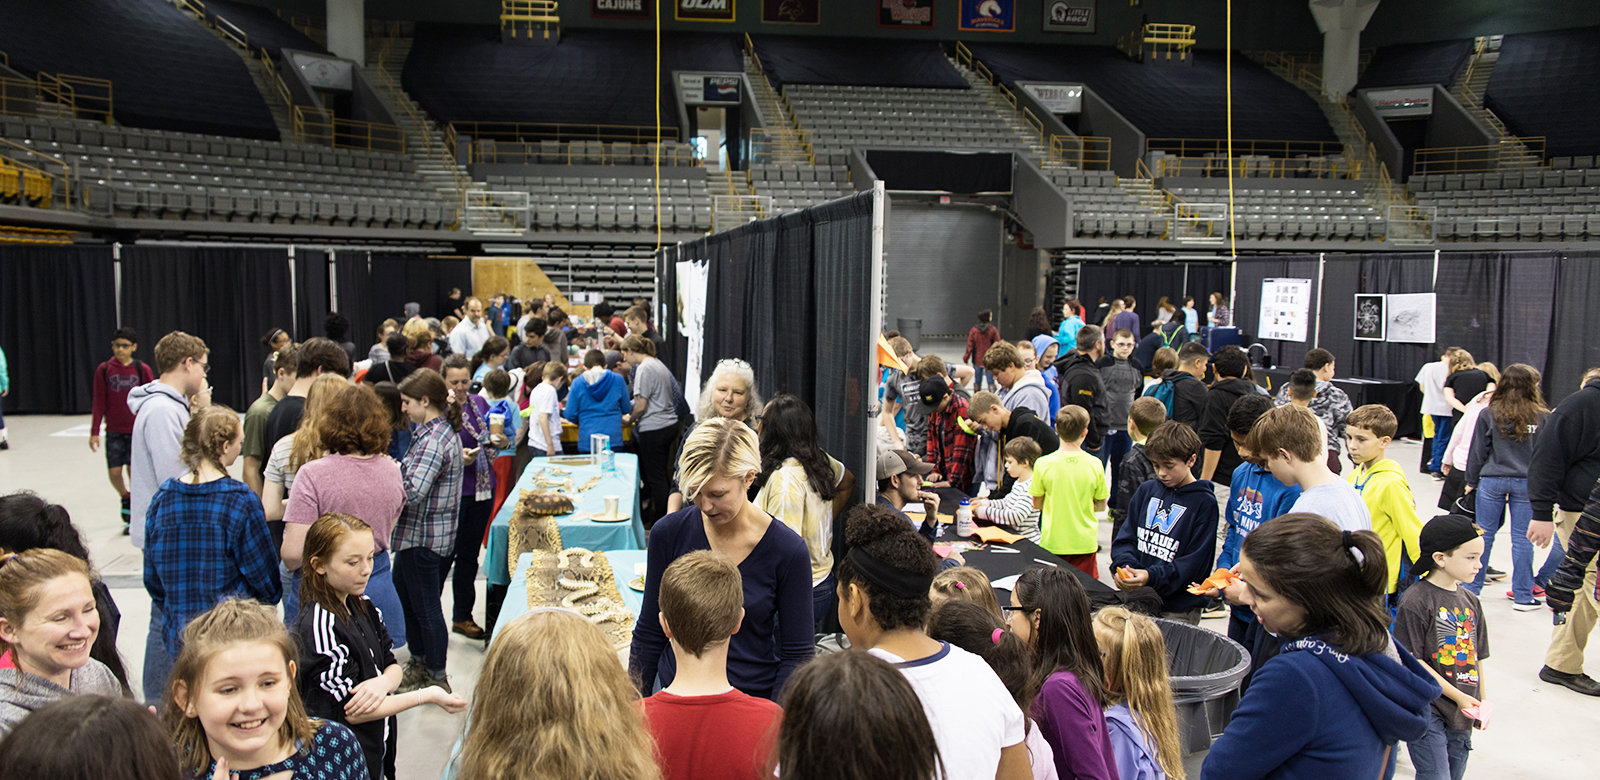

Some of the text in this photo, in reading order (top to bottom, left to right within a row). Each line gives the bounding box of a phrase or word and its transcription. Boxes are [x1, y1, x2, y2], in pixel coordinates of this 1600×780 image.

[597, 0, 642, 10] CAJUNS
[710, 77, 739, 85] PEPSI
[1240, 515, 1261, 531] NAVY
